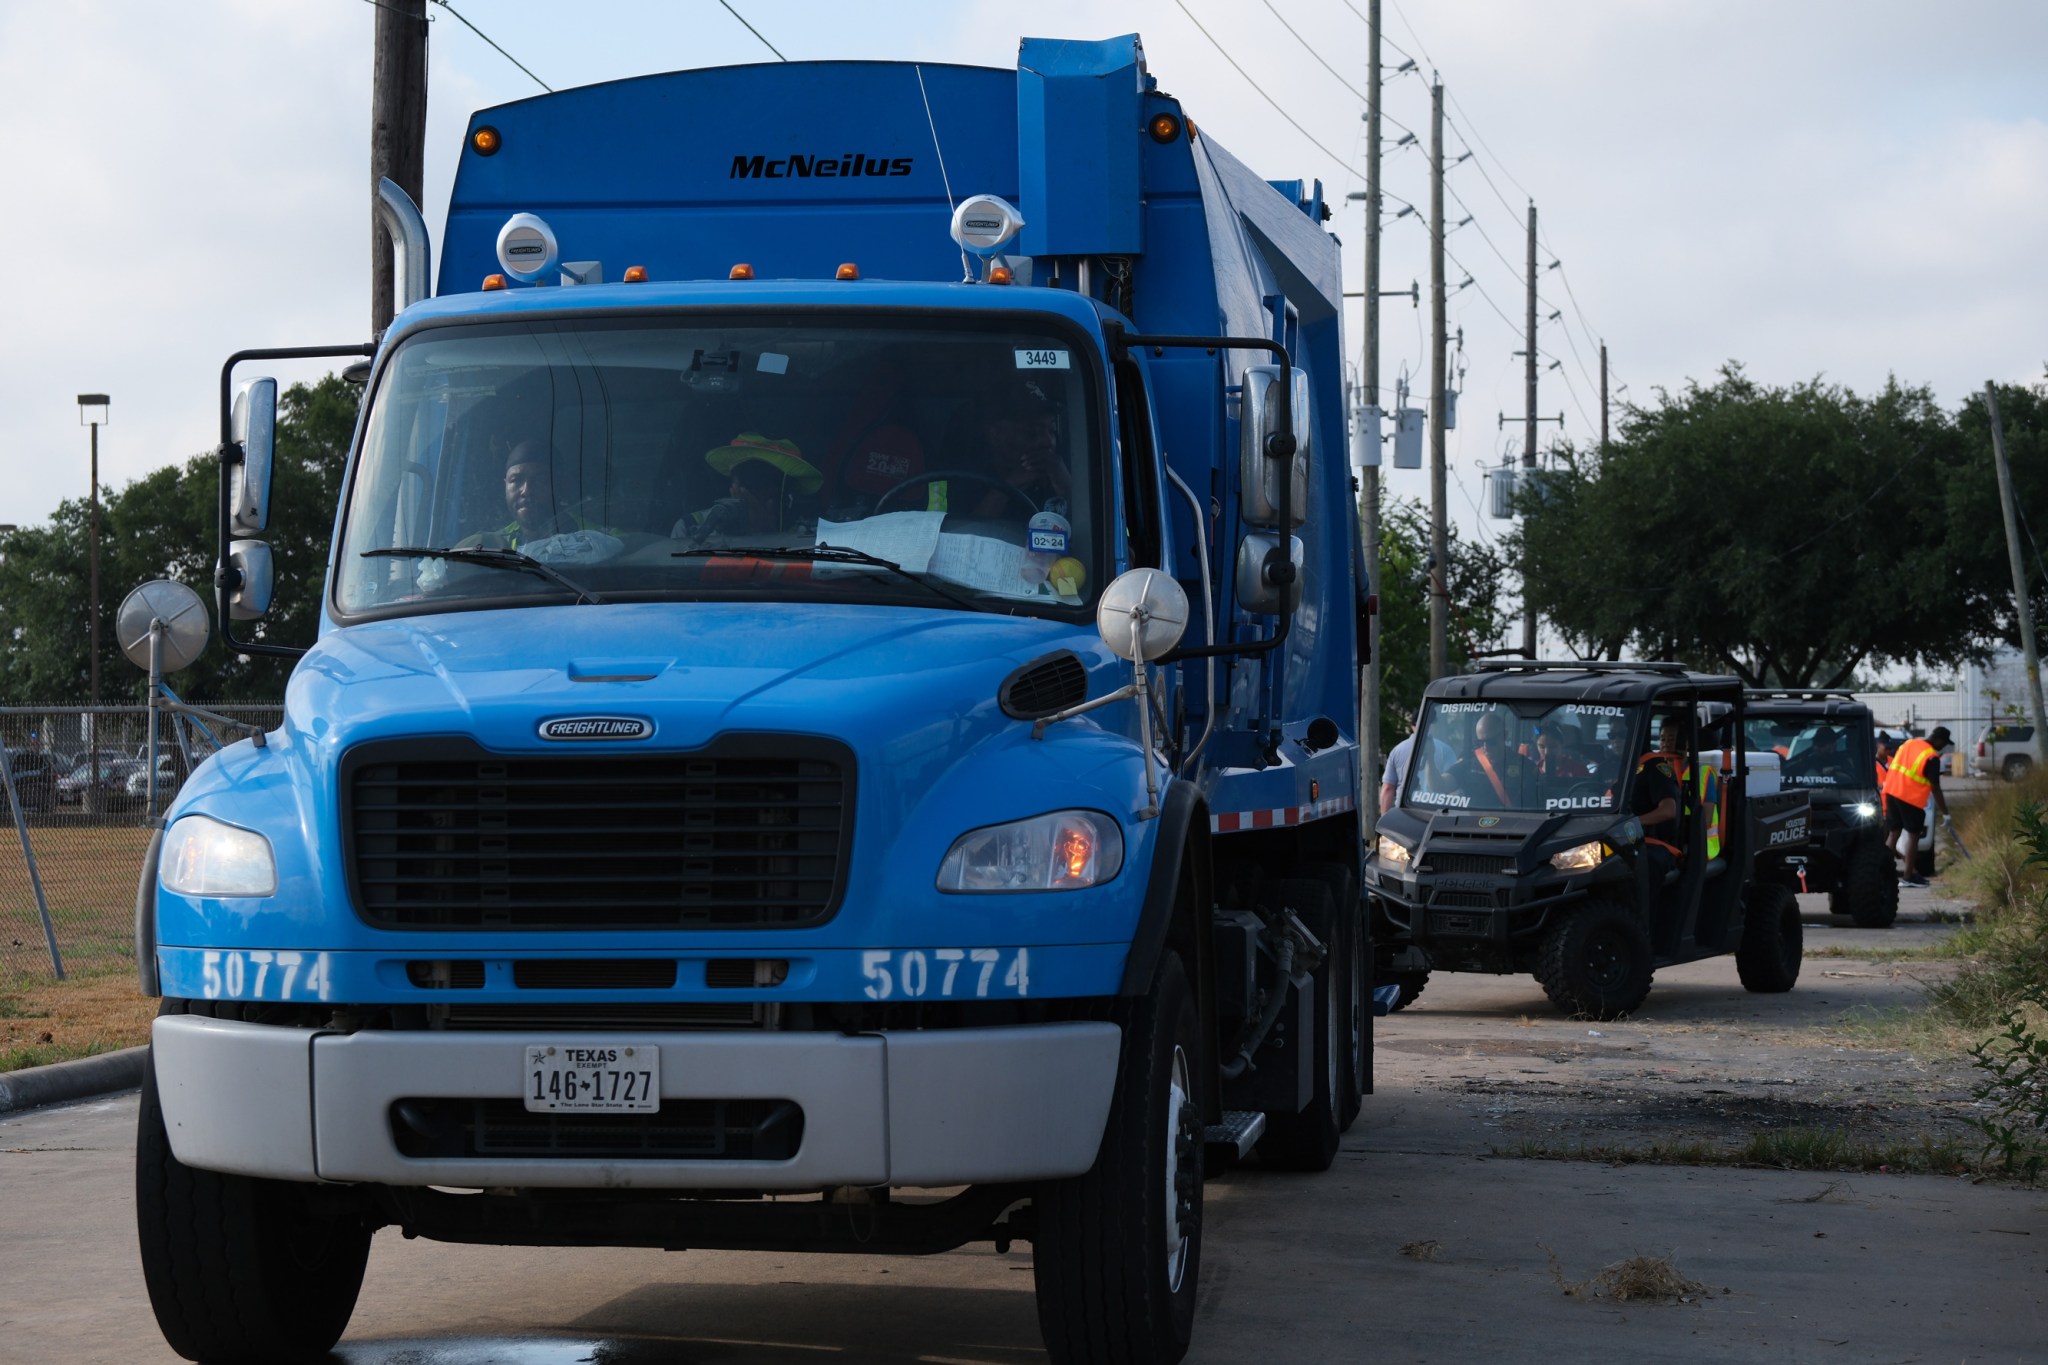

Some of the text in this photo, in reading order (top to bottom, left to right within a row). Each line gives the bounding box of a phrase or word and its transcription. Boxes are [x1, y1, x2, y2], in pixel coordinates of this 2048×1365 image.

[730, 154, 913, 179] McNeilus
[1026, 351, 1057, 366] 3449
[1441, 702, 1497, 714] DISTRICT J
[1566, 704, 1625, 717] PATROL
[550, 721, 641, 734] FREIGHTLINER
[1787, 776, 1793, 784] J
[1411, 790, 1471, 808] HOUSTON
[1545, 796, 1612, 810] POLICE
[1770, 827, 1805, 844] POLICE
[203, 951, 330, 1001] 50774
[863, 948, 1029, 999] 50774
[565, 1049, 617, 1062] TEXAS
